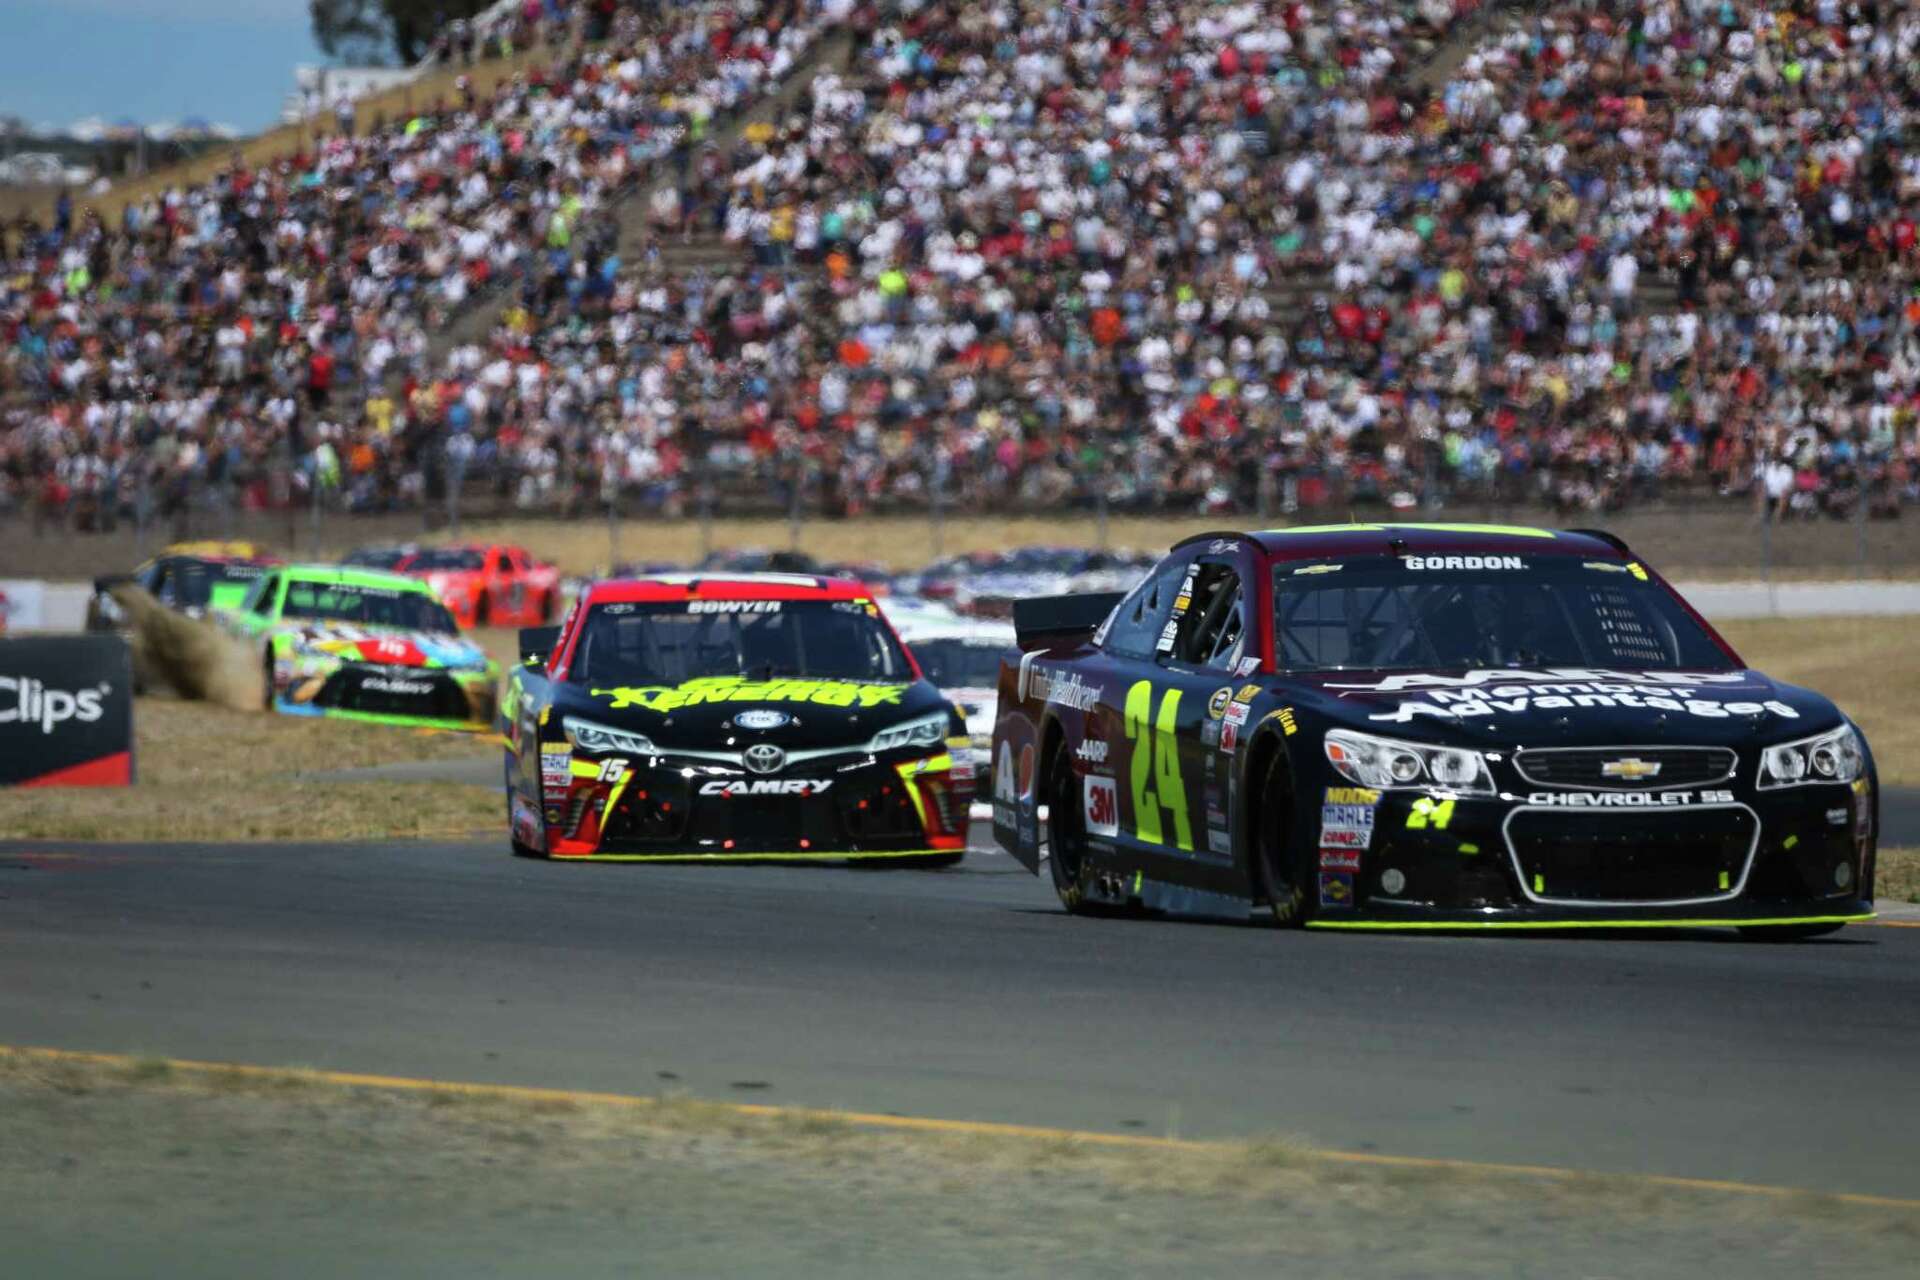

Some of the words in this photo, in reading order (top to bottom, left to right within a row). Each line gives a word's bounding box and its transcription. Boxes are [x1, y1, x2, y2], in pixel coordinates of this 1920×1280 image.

[687, 601, 781, 614] BOWYER
[1427, 681, 1697, 703] Member
[597, 758, 630, 782] 15
[1124, 680, 1194, 851] 24
[699, 779, 833, 795] CAMRY
[1528, 791, 1693, 807] CHEVROLET
[1700, 789, 1735, 803] SS
[1088, 784, 1116, 827] 3M
[1405, 797, 1456, 830] 24
